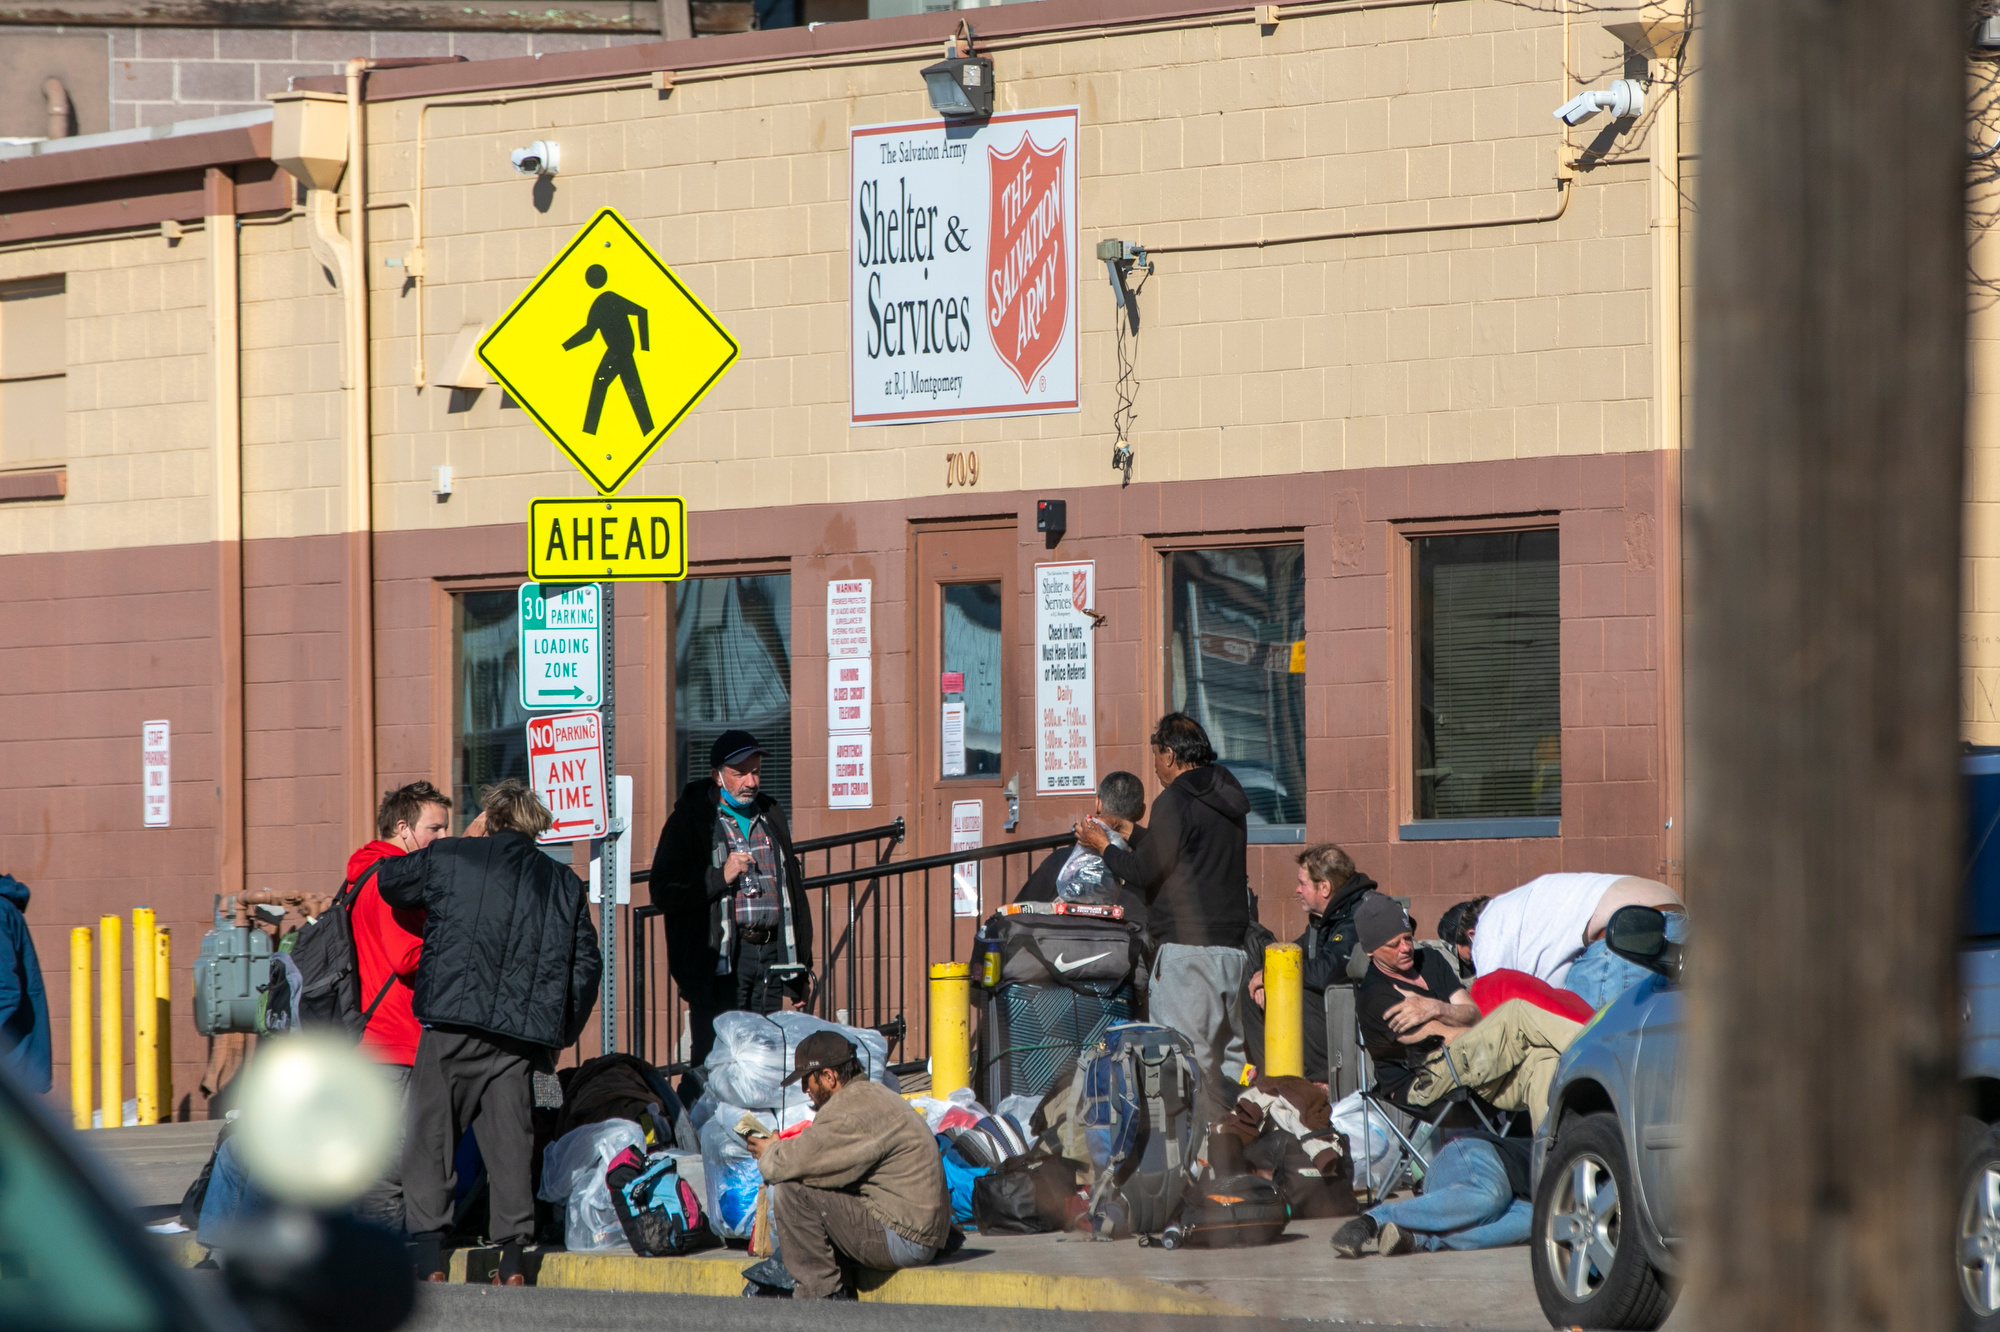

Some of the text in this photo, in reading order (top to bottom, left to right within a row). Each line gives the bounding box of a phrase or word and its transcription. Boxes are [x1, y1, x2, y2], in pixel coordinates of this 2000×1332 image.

[880, 138, 968, 164] The Salvation Army
[1002, 155, 1032, 239] THE
[858, 176, 972, 268] Shelter &
[990, 166, 1061, 328] SALVATION
[868, 267, 970, 359] Services
[1016, 240, 1058, 362] ARMY
[884, 379, 892, 396] at
[910, 370, 962, 400] Montgomery
[946, 451, 979, 488] 709
[546, 517, 670, 560] AHEAD
[836, 583, 862, 593] WARNING
[1042, 578, 1063, 594] Shelter
[524, 588, 584, 620] 30 MIN
[1045, 594, 1072, 610] Services
[551, 608, 594, 624] PARKING
[1048, 624, 1062, 640] Check
[1069, 623, 1082, 639] Hours
[534, 638, 589, 654] LOADING
[1042, 644, 1054, 661] Must
[1055, 644, 1066, 660] Have
[1067, 642, 1078, 660] Valid
[544, 662, 578, 678] ZONE
[1045, 663, 1086, 681] or Police Referral
[1057, 685, 1073, 705] Daily
[530, 724, 596, 749] NO PARKING
[548, 758, 586, 784] ANY
[546, 785, 594, 811] TIME
[962, 816, 980, 830] VISITORS
[966, 864, 973, 877] AT
